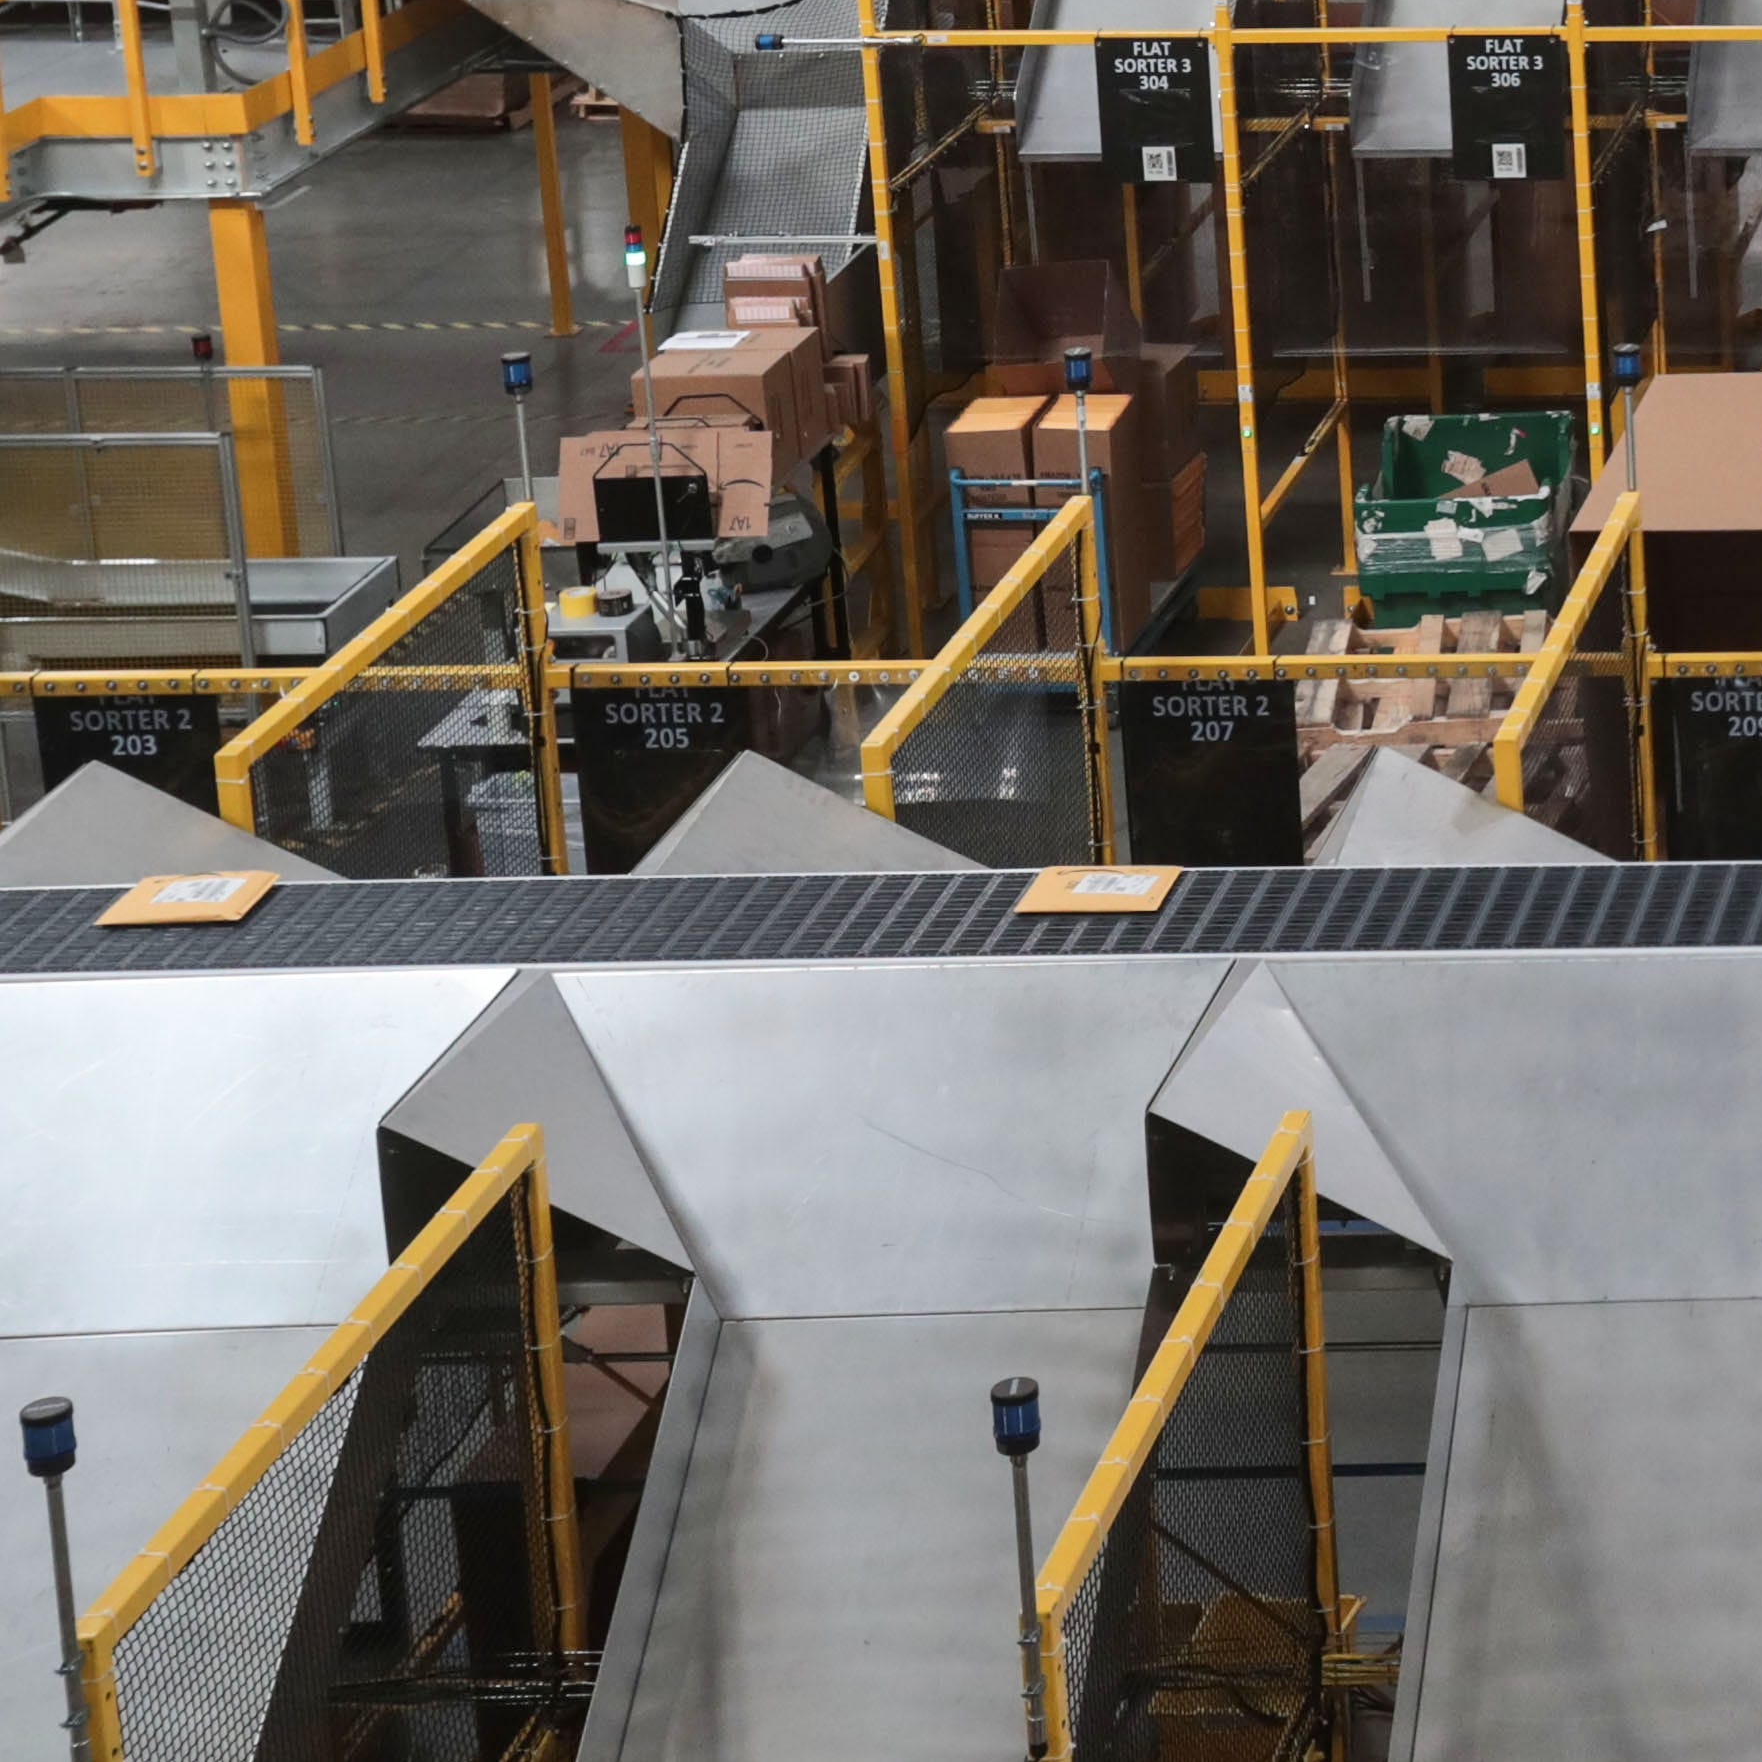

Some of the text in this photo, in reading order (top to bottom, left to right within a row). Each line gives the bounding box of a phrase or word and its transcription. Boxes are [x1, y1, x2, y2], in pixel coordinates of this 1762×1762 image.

[1131, 41, 1171, 57] FLAT
[1484, 39, 1524, 55] FLAT
[1114, 57, 1192, 74] SORTER 3
[1467, 55, 1544, 72] SORTER 3
[1139, 74, 1169, 90] 304
[1491, 72, 1521, 88] 306
[729, 516, 751, 532] 1A7
[606, 701, 724, 725] SORTER 2
[1153, 693, 1271, 716] SORTER 2
[70, 710, 192, 734] SORTER 2
[1190, 719, 1234, 741] 207
[110, 735, 158, 757] 203
[645, 727, 691, 749] 205
